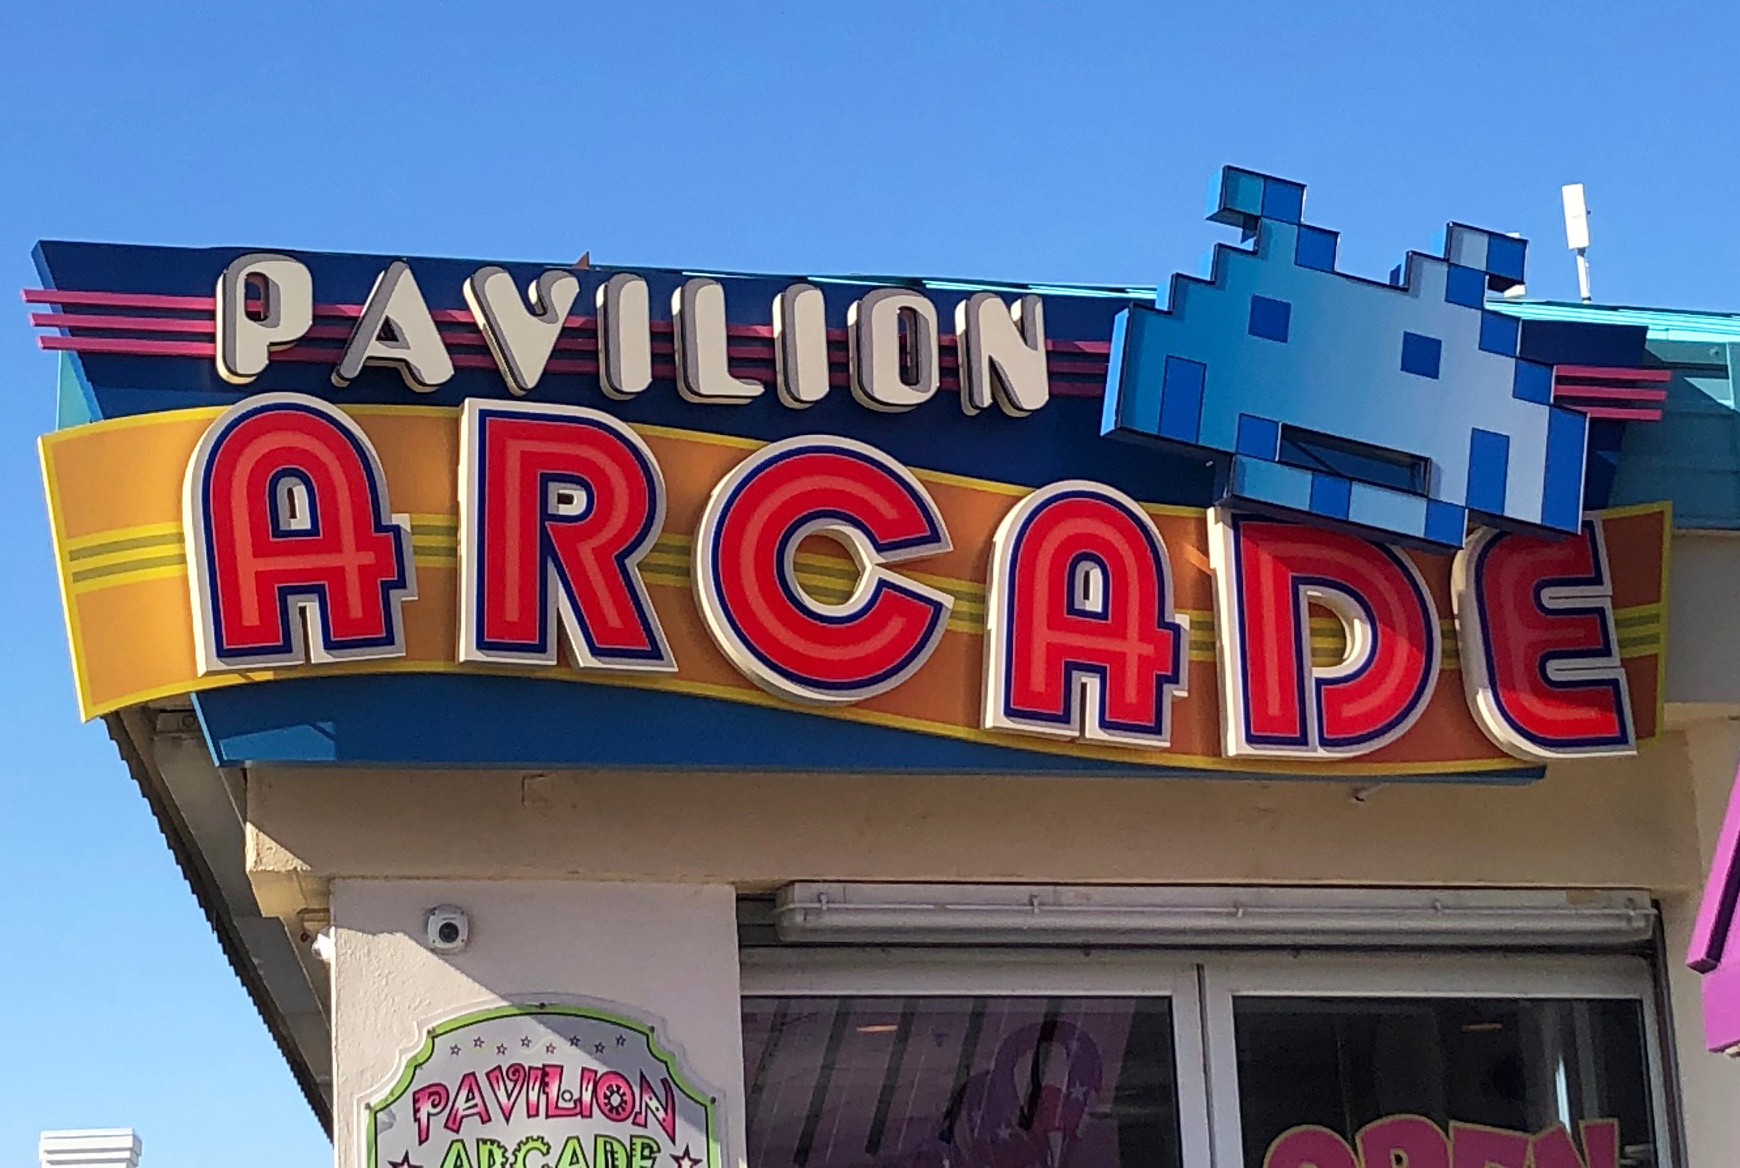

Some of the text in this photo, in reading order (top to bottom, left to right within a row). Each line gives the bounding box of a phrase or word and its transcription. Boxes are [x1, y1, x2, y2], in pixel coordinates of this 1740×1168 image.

[214, 252, 1050, 418] PAVILION
[182, 392, 1638, 760] ARCADE
[412, 1063, 676, 1146] PAVILION
